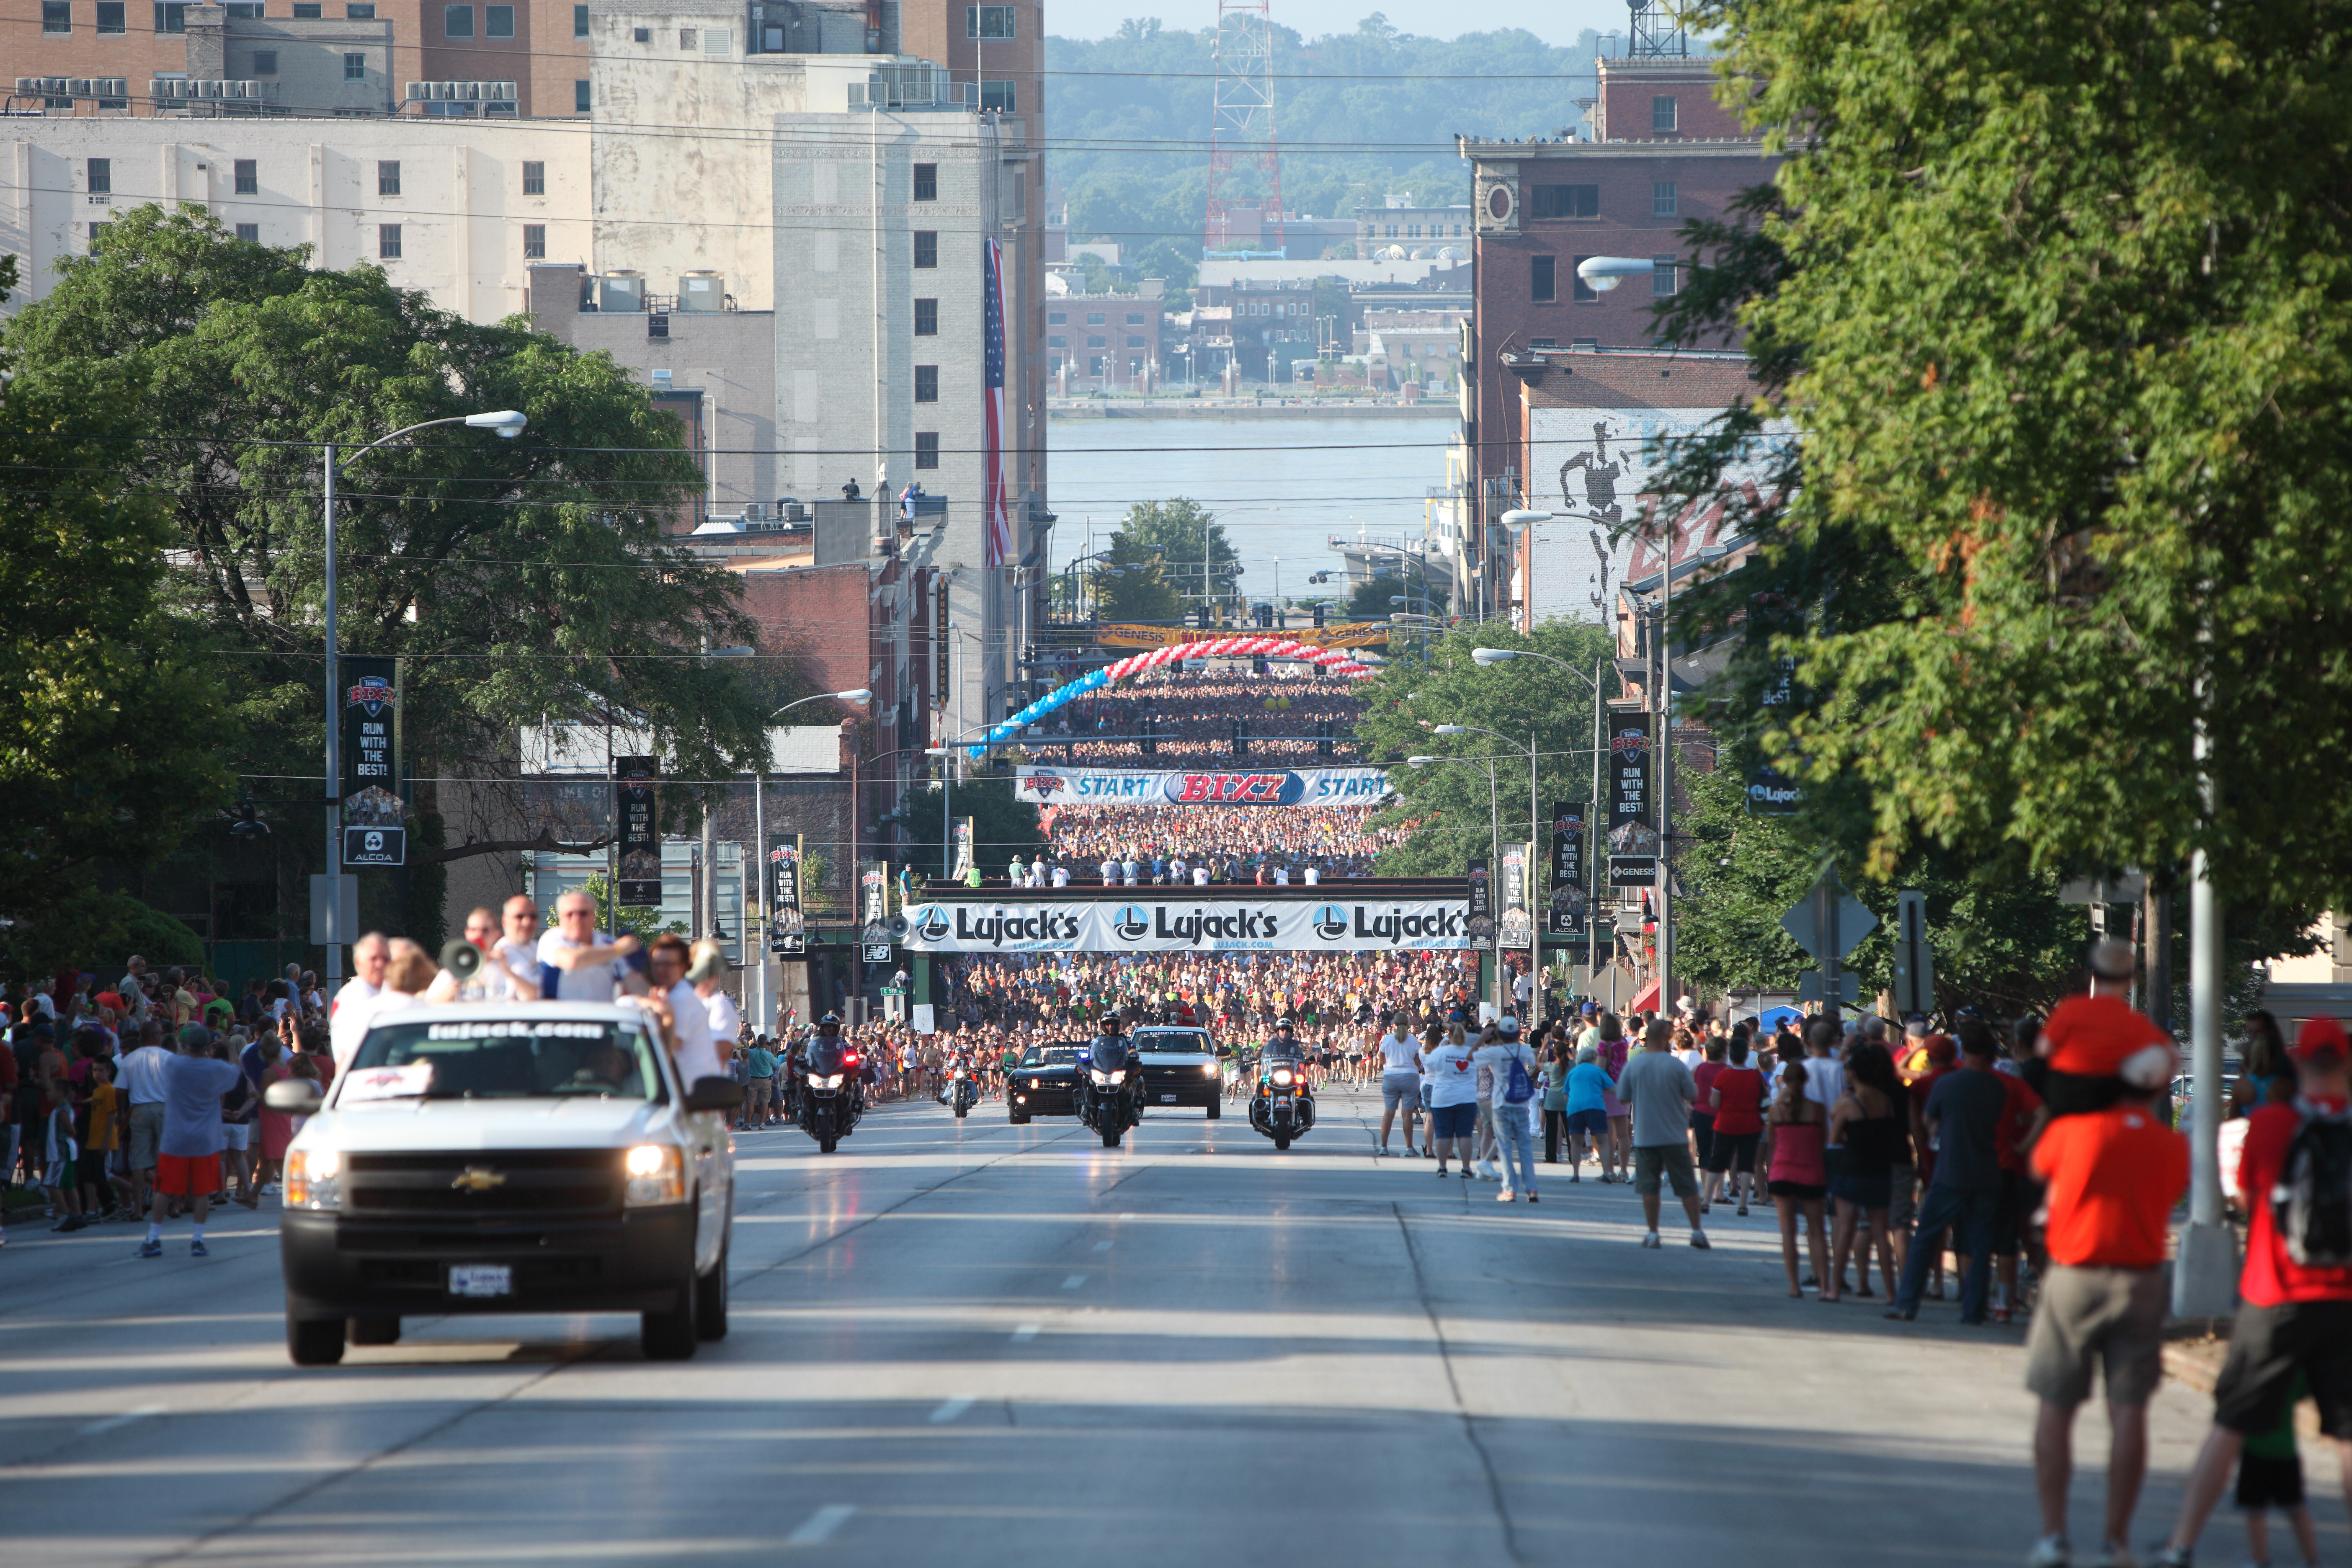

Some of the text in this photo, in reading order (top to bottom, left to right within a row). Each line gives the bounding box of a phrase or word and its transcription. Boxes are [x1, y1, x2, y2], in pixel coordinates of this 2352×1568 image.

[1114, 627, 1165, 642] GENESIS
[351, 686, 395, 704] BIX7
[363, 723, 383, 735] RUN
[360, 736, 386, 748] WITH
[1613, 737, 1650, 753] BIX7
[363, 750, 382, 762] THE
[358, 764, 387, 776] BEST!
[1623, 768, 1640, 778] RUN
[1026, 777, 1063, 791] BIX7
[1078, 778, 1149, 796] START
[1179, 773, 1287, 802] BIX7
[1621, 779, 1643, 789] WITH
[1624, 791, 1640, 801] THE
[631, 803, 645, 812] RUN
[1620, 802, 1643, 812] BEST!
[629, 813, 648, 822] WITH
[631, 823, 645, 832] THE
[1556, 821, 1584, 832] BIX7
[629, 833, 648, 842] BEST!
[772, 850, 798, 861] BIX7
[957, 908, 1078, 947] Lujack's
[1156, 907, 1277, 945] Lujack's
